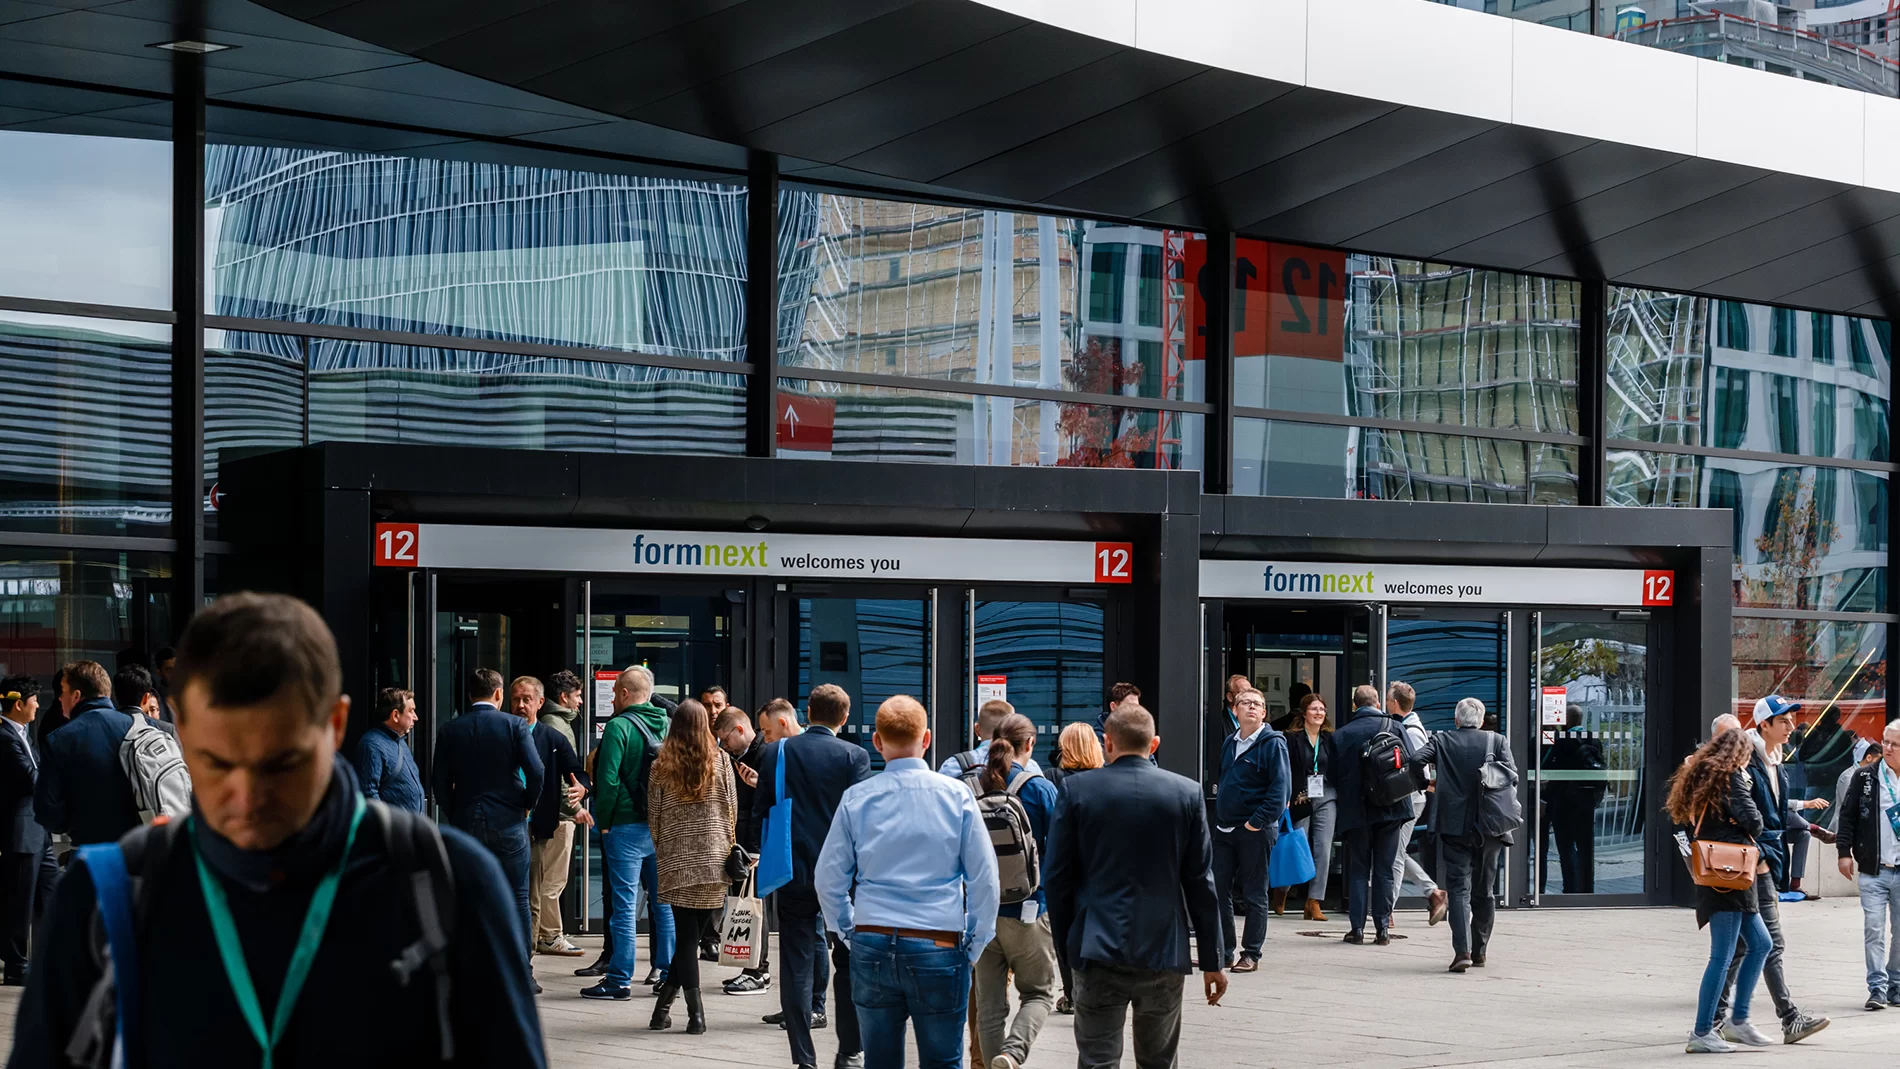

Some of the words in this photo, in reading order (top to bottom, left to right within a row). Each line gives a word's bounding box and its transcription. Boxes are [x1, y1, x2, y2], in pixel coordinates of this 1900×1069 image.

[380, 530, 415, 560] 12
[633, 534, 768, 568] formnext
[781, 553, 865, 570] welcomes
[870, 556, 900, 574] you
[1098, 549, 1129, 577] 12
[1263, 565, 1375, 594] formnext
[1384, 581, 1454, 596] welcomes
[1458, 585, 1482, 599] you
[1645, 576, 1671, 601] 12
